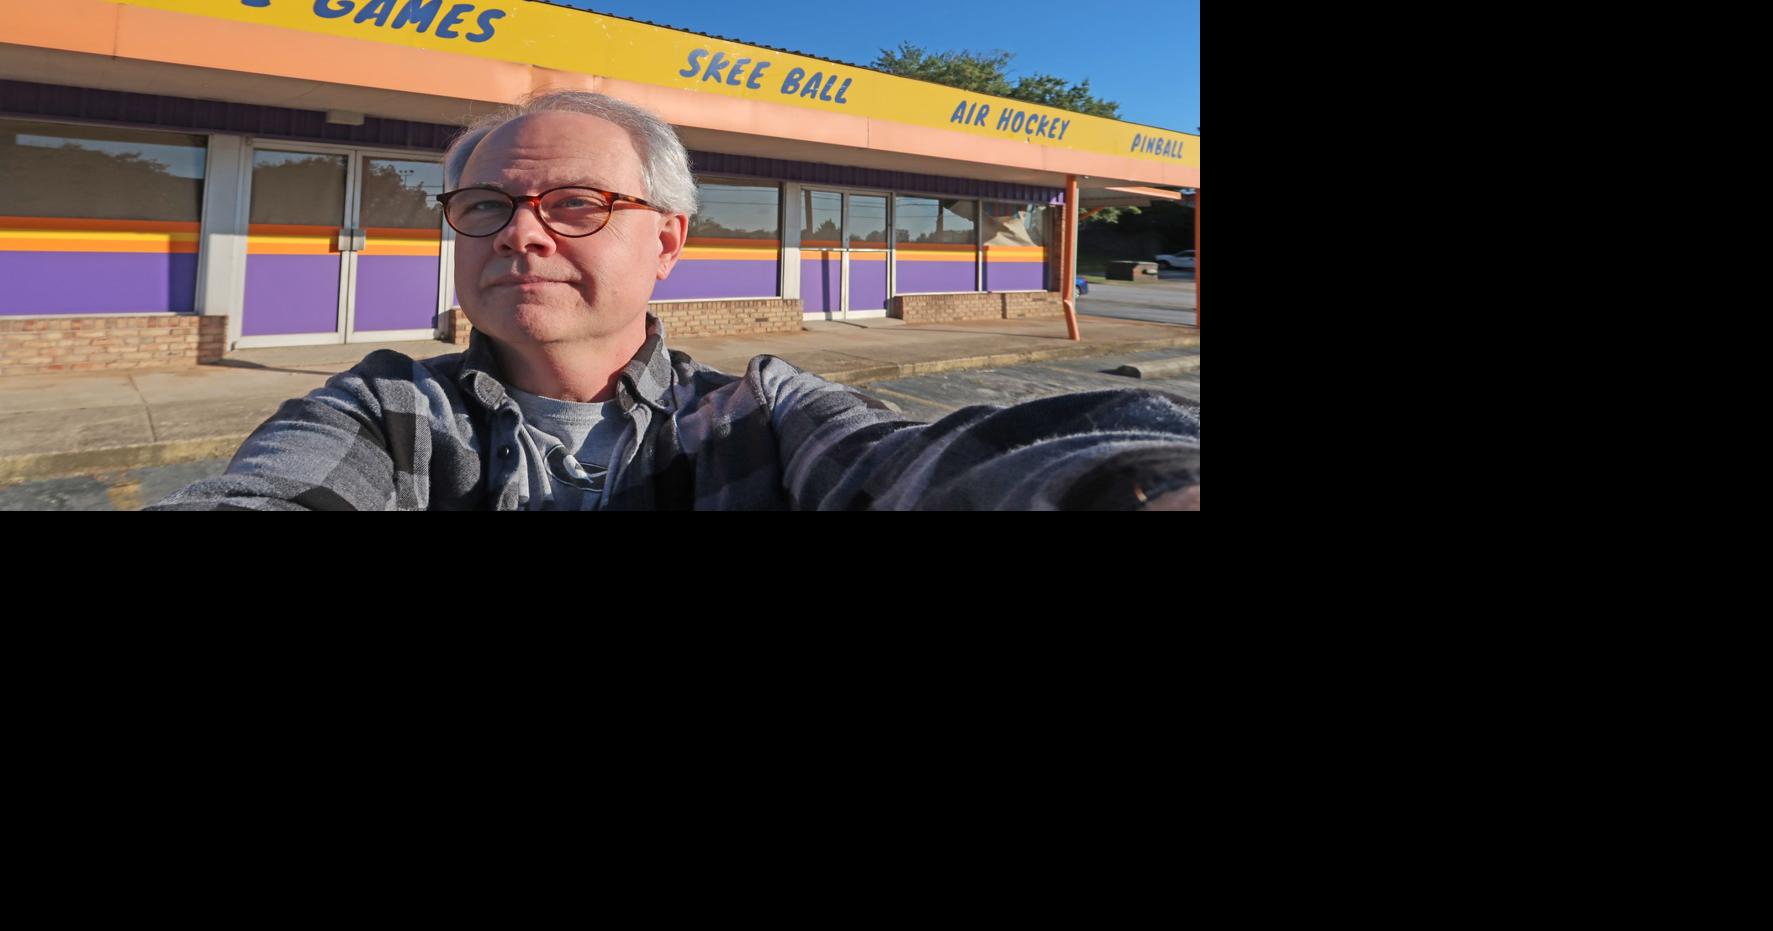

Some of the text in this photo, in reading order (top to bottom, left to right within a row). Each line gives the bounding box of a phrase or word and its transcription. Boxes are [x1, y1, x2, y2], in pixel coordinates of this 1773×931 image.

[313, 0, 506, 43] GAMES
[679, 48, 853, 104] SKEE BALL
[950, 100, 1070, 140] AIR HOCKEY
[1130, 133, 1184, 159] PINBALL
